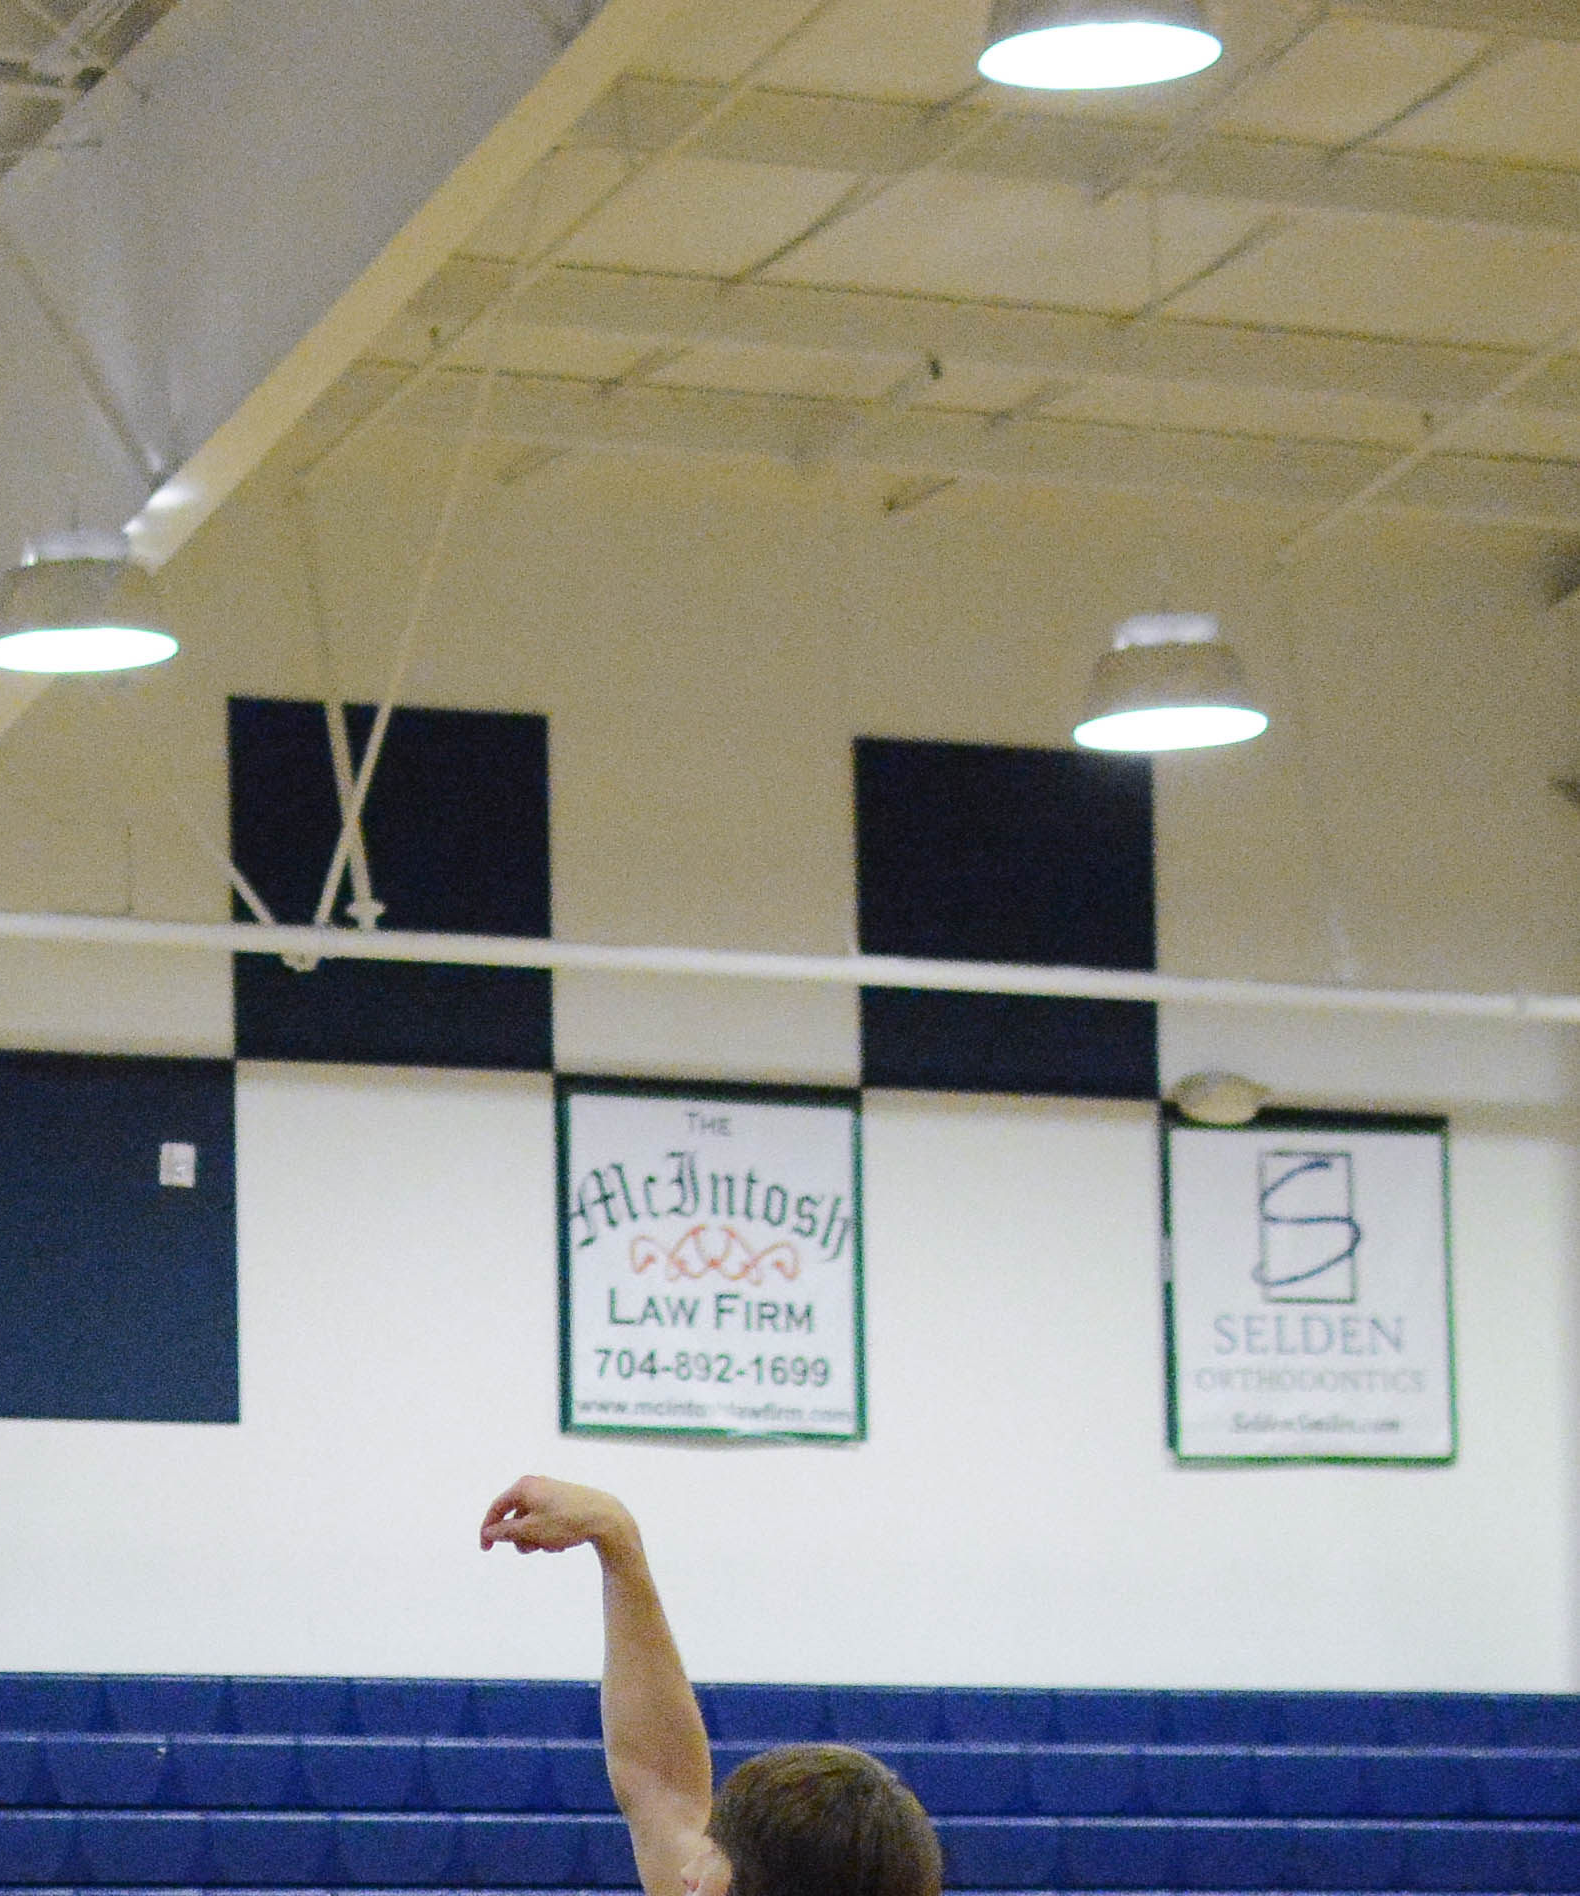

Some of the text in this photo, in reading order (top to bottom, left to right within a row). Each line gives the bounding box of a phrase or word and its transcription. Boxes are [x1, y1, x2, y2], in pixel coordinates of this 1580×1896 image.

[687, 1111, 733, 1137] THE
[608, 1286, 815, 1334] LAW FIRM
[1213, 1313, 1404, 1356] SELDEN
[594, 1347, 833, 1389] 704-892-1699
